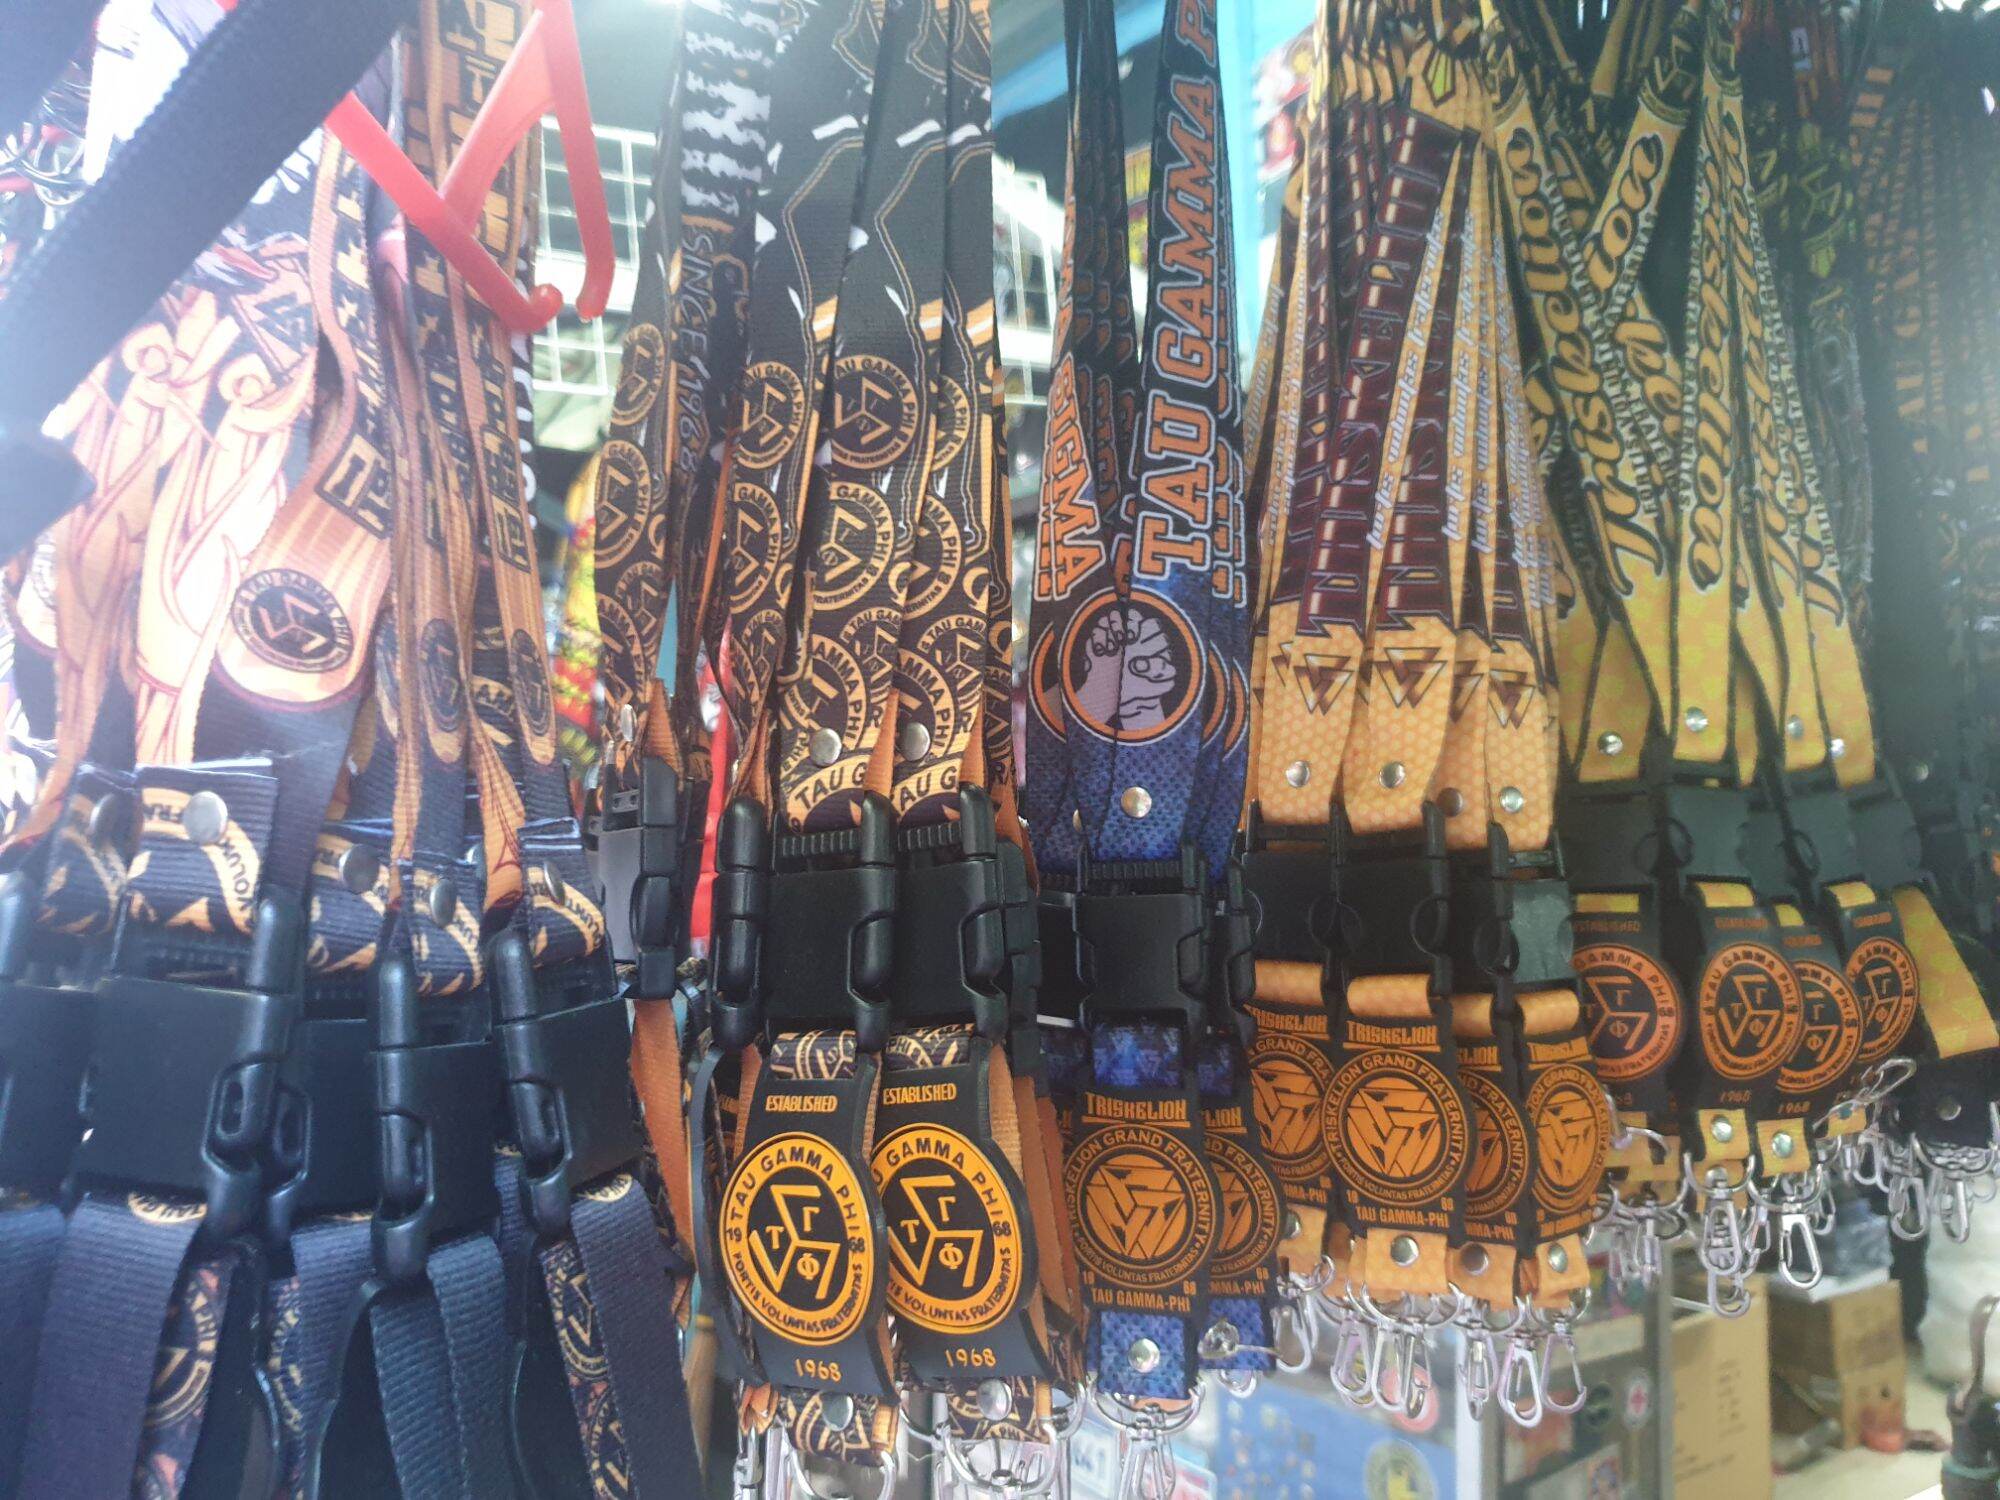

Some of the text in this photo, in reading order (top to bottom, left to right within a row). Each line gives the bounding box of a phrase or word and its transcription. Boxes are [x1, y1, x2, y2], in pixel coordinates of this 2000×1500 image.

[679, 227, 714, 353] SINCE
[1134, 74, 1216, 580] TAU GAMMA
[834, 357, 857, 379] AU
[1506, 127, 1664, 596] Triskelion
[1050, 352, 1106, 601] SIGMA
[836, 485, 890, 563] GAMMA PHI
[941, 534, 957, 568] PHI
[850, 610, 874, 633] TAU
[926, 620, 951, 640] TAU
[812, 641, 864, 746] AMMA PHI
[903, 657, 952, 750] MMA PHI
[794, 765, 844, 811] TAU
[900, 773, 931, 812] AU
[1574, 952, 1668, 1003] GAMMA PHI
[1722, 950, 1776, 971] GAMMA
[1778, 973, 1795, 1002] PHI
[1835, 988, 1854, 1021] PHI
[1256, 1038, 1305, 1054] GRAND
[1347, 1020, 1438, 1044] TRISKELION
[766, 1095, 837, 1113] ESTABLISHED
[883, 1083, 957, 1104] ESTABLISHED
[1086, 1092, 1188, 1120] TRISKELION
[1326, 1054, 1463, 1162] TRISKELION GRAND FRATERNITY
[1480, 1086, 1524, 1180] FRATERNITY
[731, 1173, 756, 1222] TAU
[762, 1146, 834, 1182] GAMMA
[839, 1187, 860, 1234] PHI
[887, 1137, 1003, 1218] GAMMA PHI
[1103, 1129, 1164, 1146] GRAND
[1164, 1142, 1209, 1245] FRATERNITY
[1226, 1141, 1274, 1235] FRATERNITY
[992, 1221, 1011, 1236] 68
[733, 1252, 763, 1301] FORTIS
[761, 1296, 822, 1332] VOLUNTAS
[904, 1292, 970, 1322] VOLUNTAS
[969, 1247, 1012, 1320] FRATERNITAS
[1092, 1287, 1112, 1304] TAU
[1102, 1261, 1147, 1283] VOLUNTAS
[795, 1358, 842, 1382] 1968
[945, 1347, 996, 1368] 1968
